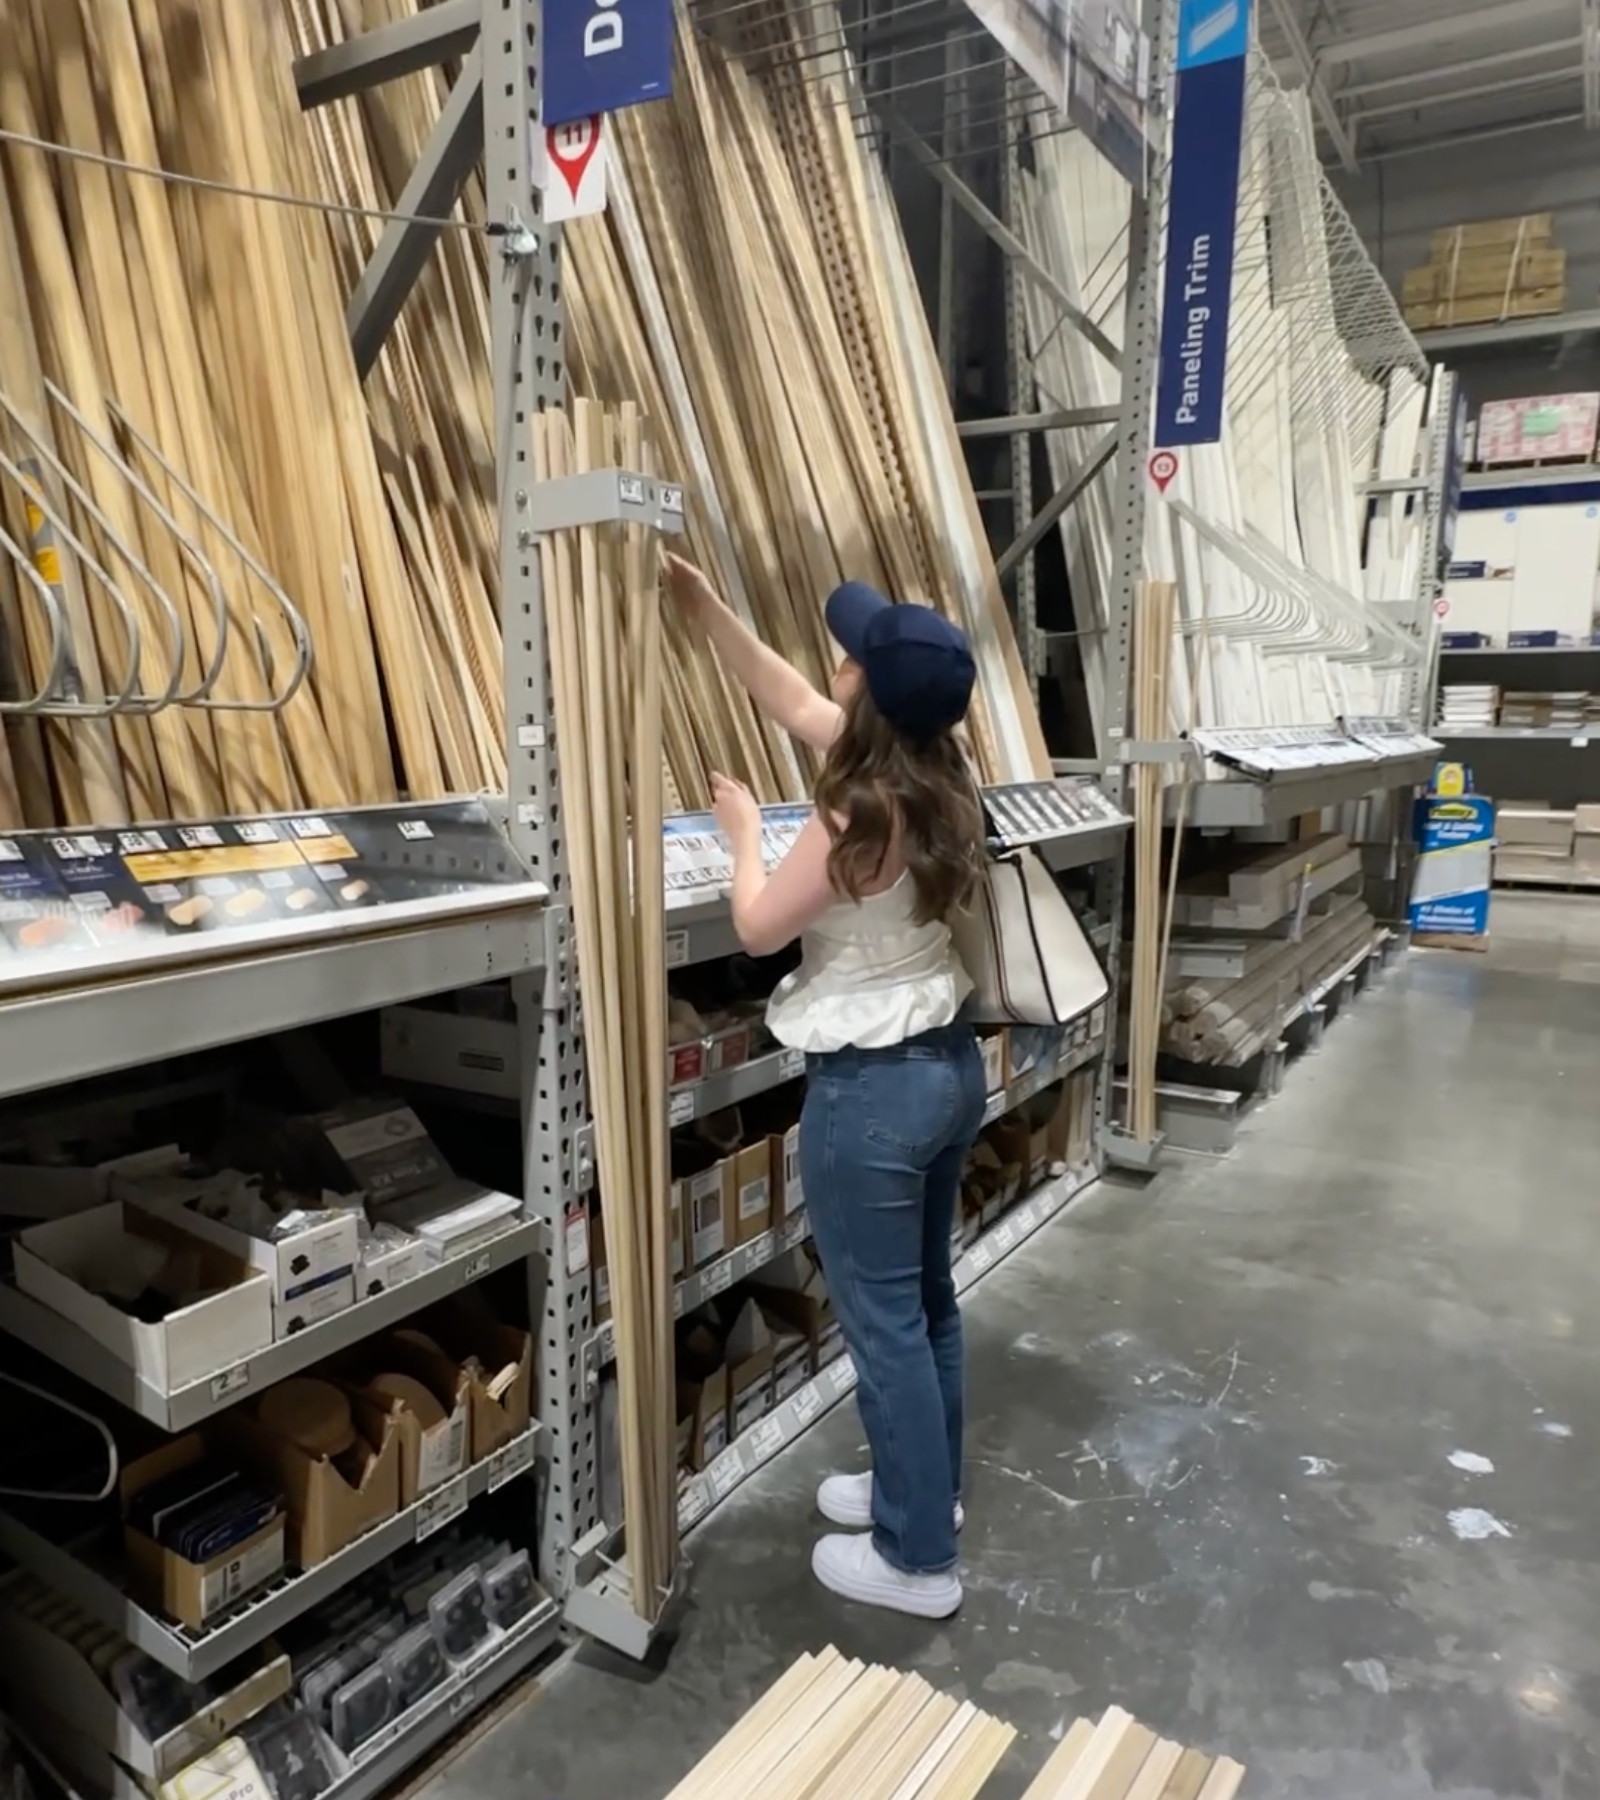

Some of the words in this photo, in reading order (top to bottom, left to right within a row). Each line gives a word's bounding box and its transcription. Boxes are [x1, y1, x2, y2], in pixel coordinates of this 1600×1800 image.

[584, 0, 623, 57] D
[563, 123, 583, 145] 11
[1184, 234, 1211, 302] Trim
[1174, 306, 1210, 424] Paneling
